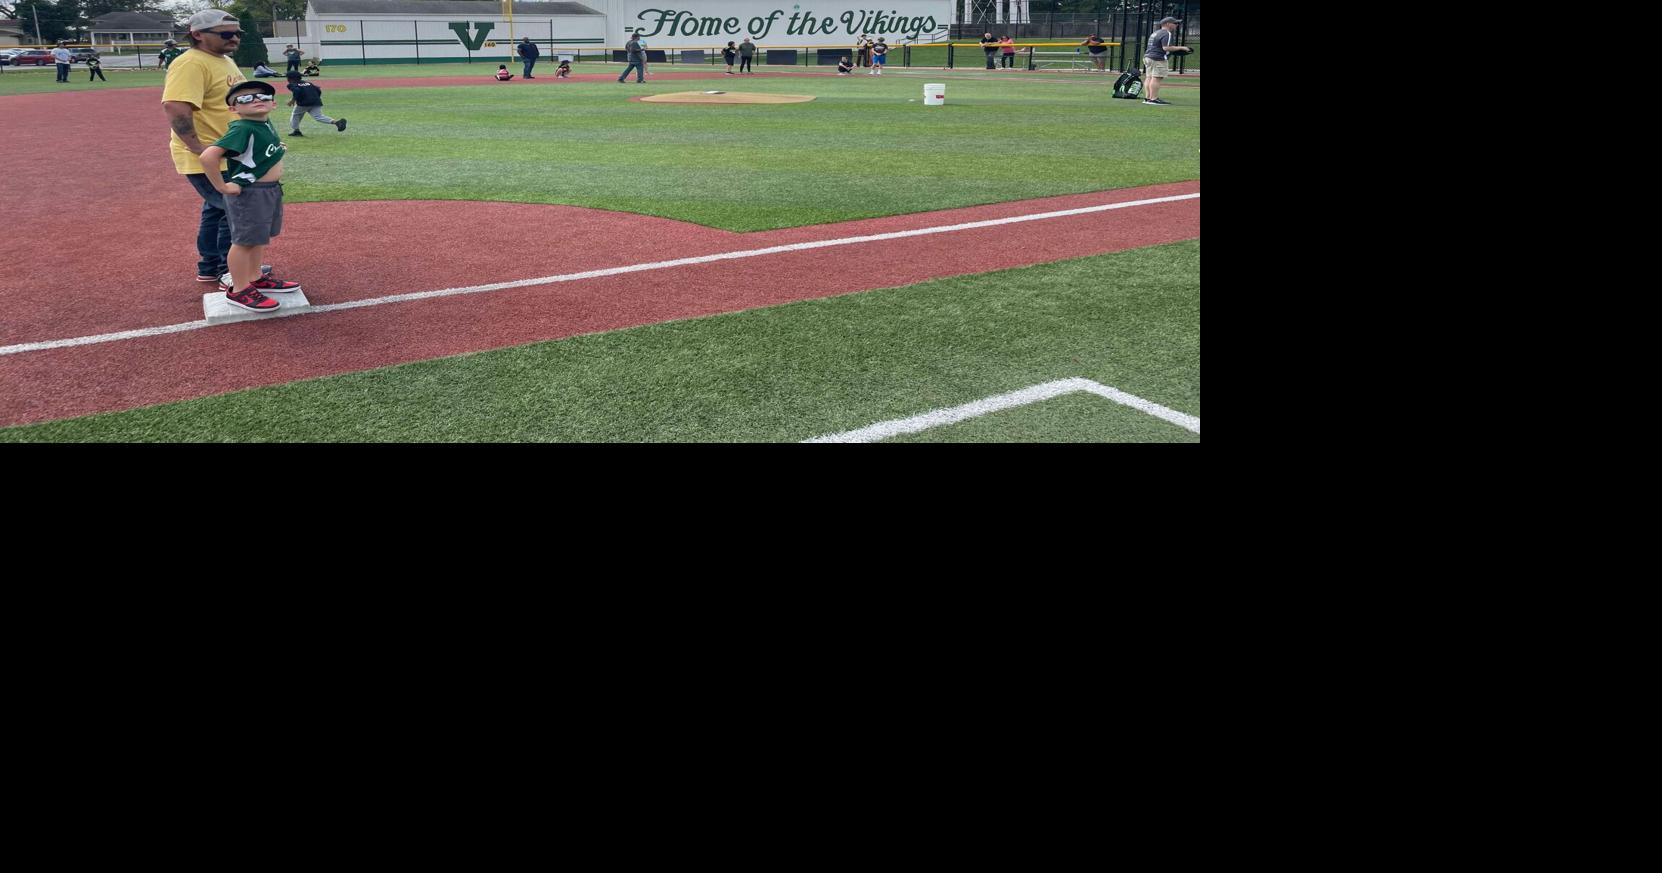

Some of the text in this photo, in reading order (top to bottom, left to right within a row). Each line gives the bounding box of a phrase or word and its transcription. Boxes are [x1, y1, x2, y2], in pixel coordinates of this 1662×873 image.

[448, 22, 495, 51] V
[634, 8, 937, 40] Home of the Vikings
